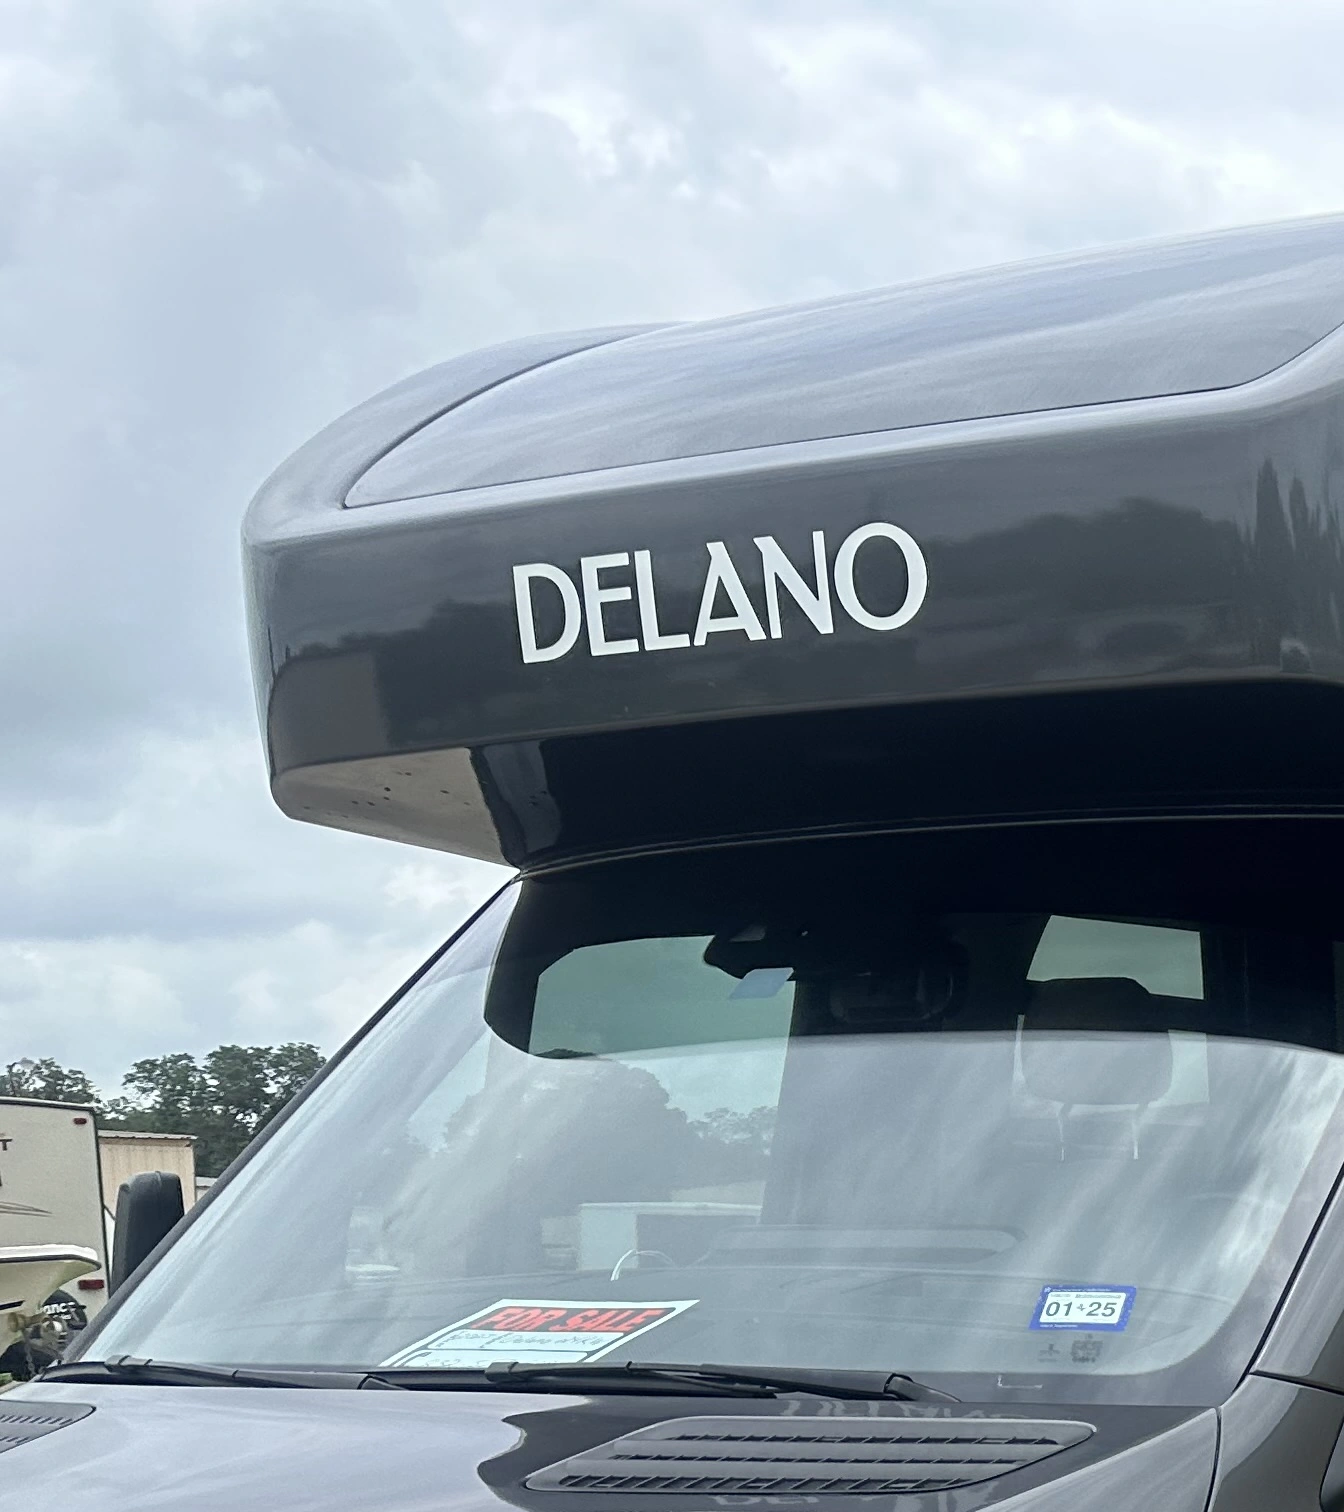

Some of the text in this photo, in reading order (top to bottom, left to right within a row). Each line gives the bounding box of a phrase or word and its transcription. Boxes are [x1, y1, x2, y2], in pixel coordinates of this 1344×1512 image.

[512, 522, 928, 663] DELANO
[472, 1308, 664, 1331] FOR SALE
[1045, 1301, 1117, 1317] 01 25
